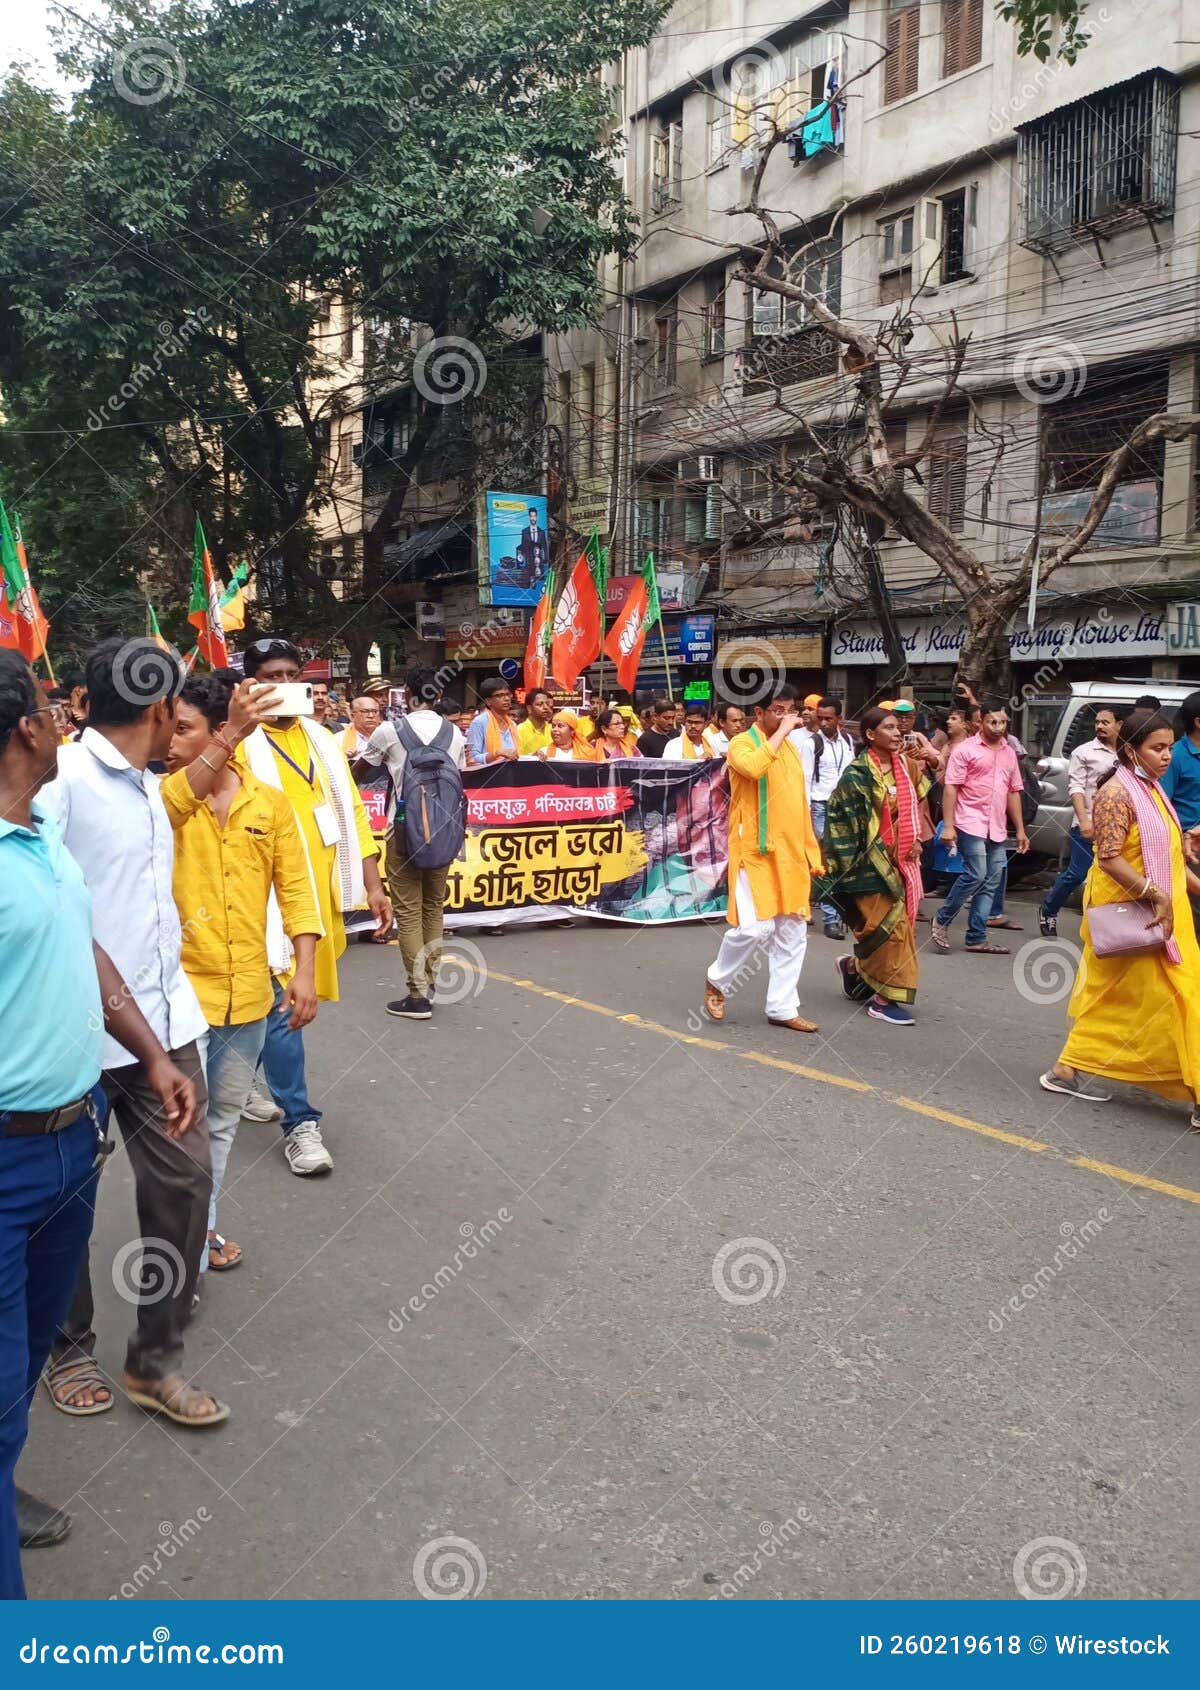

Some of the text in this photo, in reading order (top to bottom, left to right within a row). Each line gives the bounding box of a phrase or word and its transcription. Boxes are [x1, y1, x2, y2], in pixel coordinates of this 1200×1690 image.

[834, 627, 920, 655] Stanrd
[925, 625, 968, 652] Radi
[1070, 615, 1129, 645] House
[480, 829, 559, 862] জেলে
[566, 823, 624, 857] ভরো
[473, 863, 525, 903] গদি
[532, 863, 602, 901] ছাড়ো
